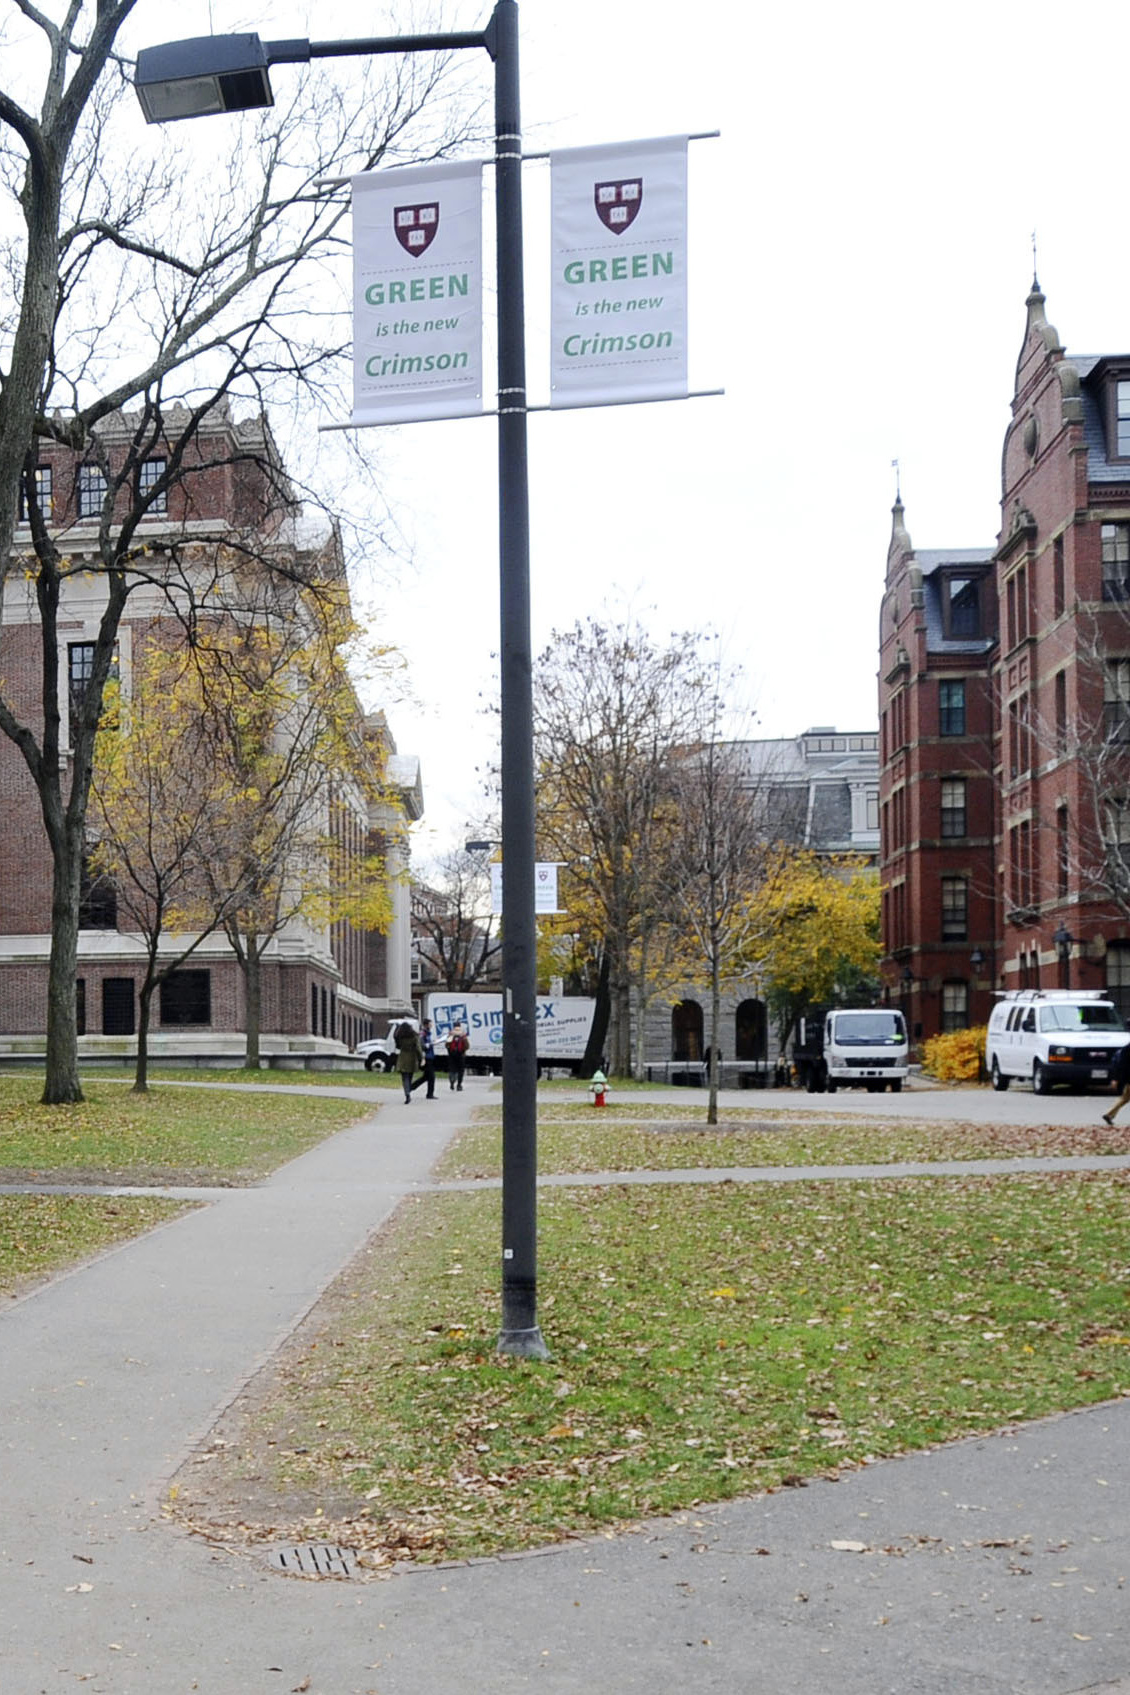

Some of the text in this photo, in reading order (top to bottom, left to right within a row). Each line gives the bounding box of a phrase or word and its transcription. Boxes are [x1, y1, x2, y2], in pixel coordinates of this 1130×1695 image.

[564, 252, 673, 284] GREEN
[365, 274, 468, 305] GREEN
[575, 297, 664, 316] is the new
[376, 318, 459, 337] is the new
[563, 331, 673, 357] Crimson
[365, 352, 468, 377] Crimson
